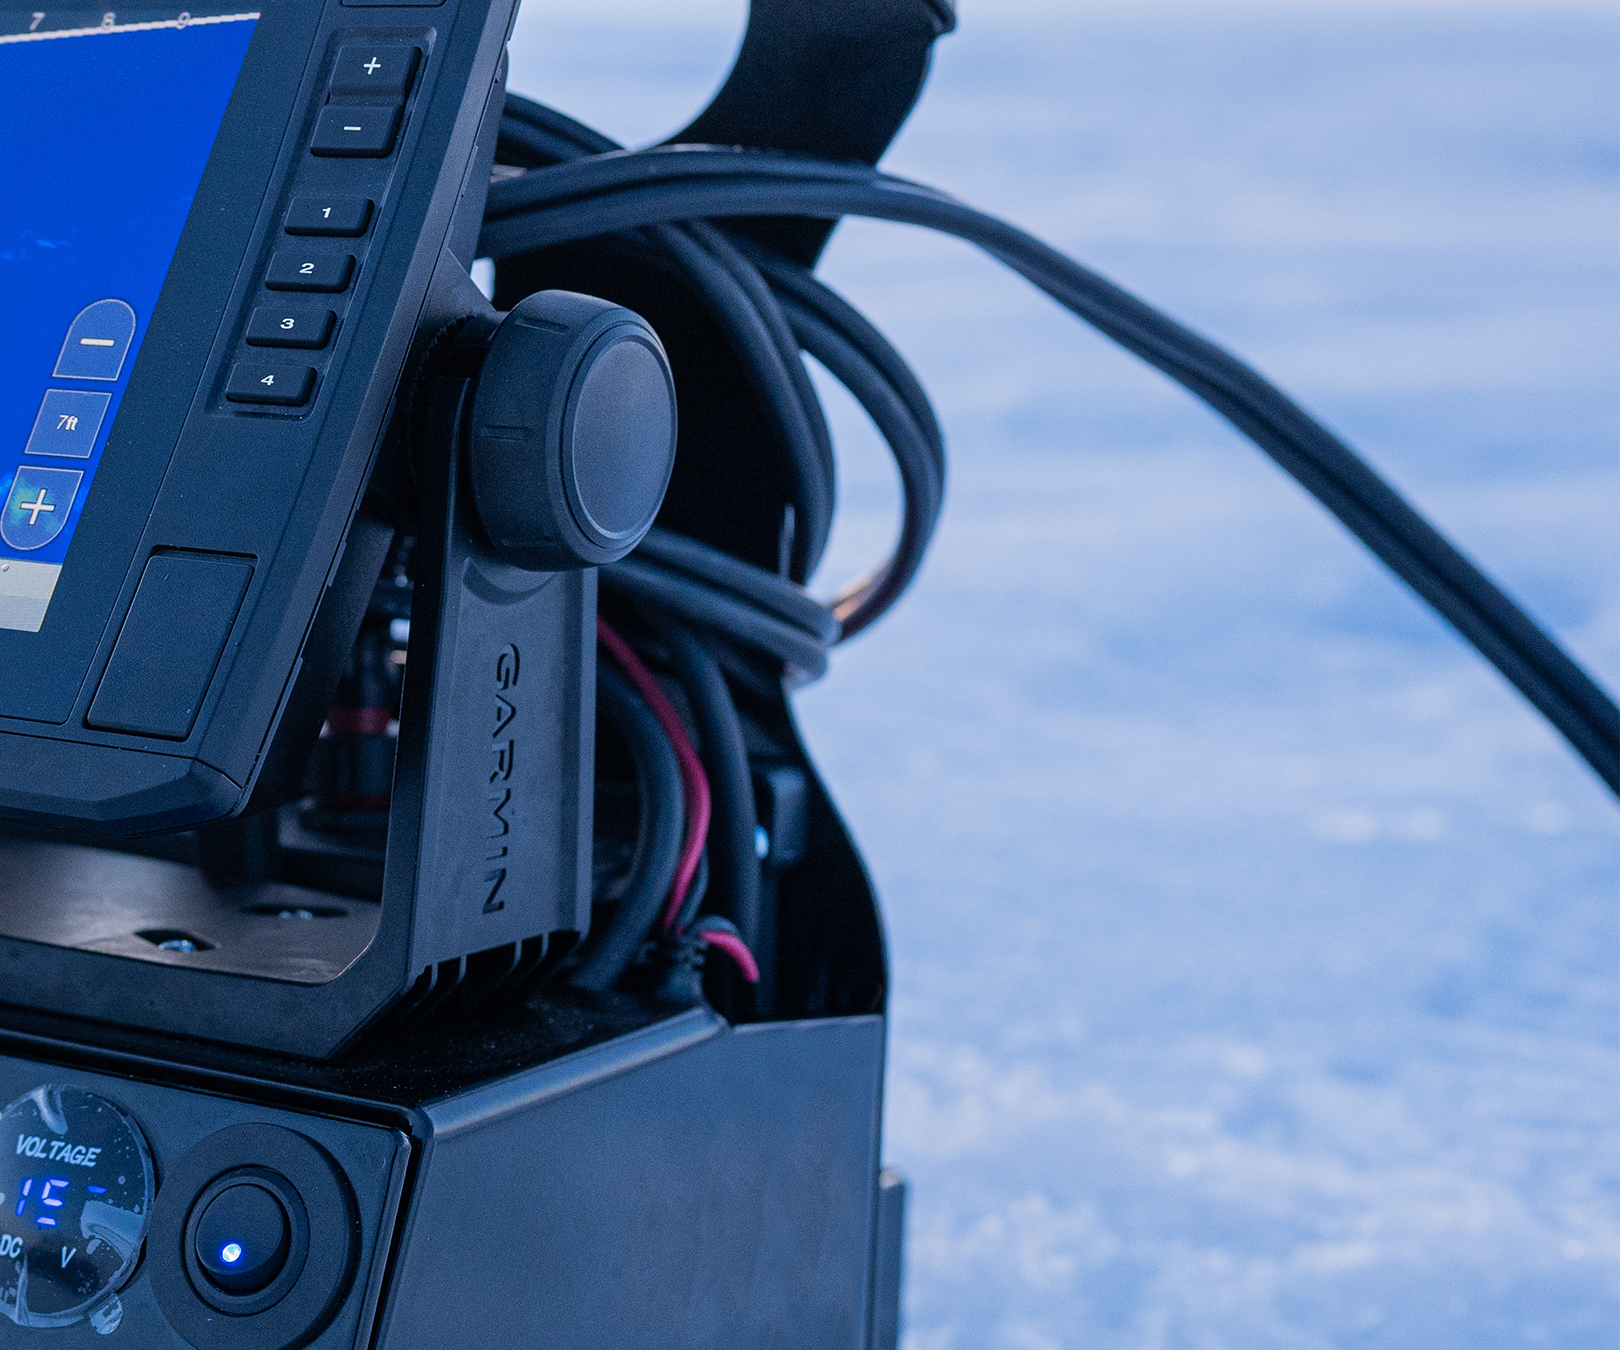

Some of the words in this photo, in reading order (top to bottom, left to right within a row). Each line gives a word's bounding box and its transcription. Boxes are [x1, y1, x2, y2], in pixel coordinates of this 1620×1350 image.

[30, 12, 45, 31] 7
[101, 12, 116, 31] 8
[177, 12, 191, 30] 9
[322, 208, 332, 218] 1
[299, 263, 314, 274] 2
[280, 318, 294, 329] 3
[260, 374, 275, 385] 4
[56, 414, 78, 431] 7ft
[482, 643, 520, 915] GARMIN
[16, 1134, 101, 1167] VOLTAGE
[60, 1246, 77, 1268] V
